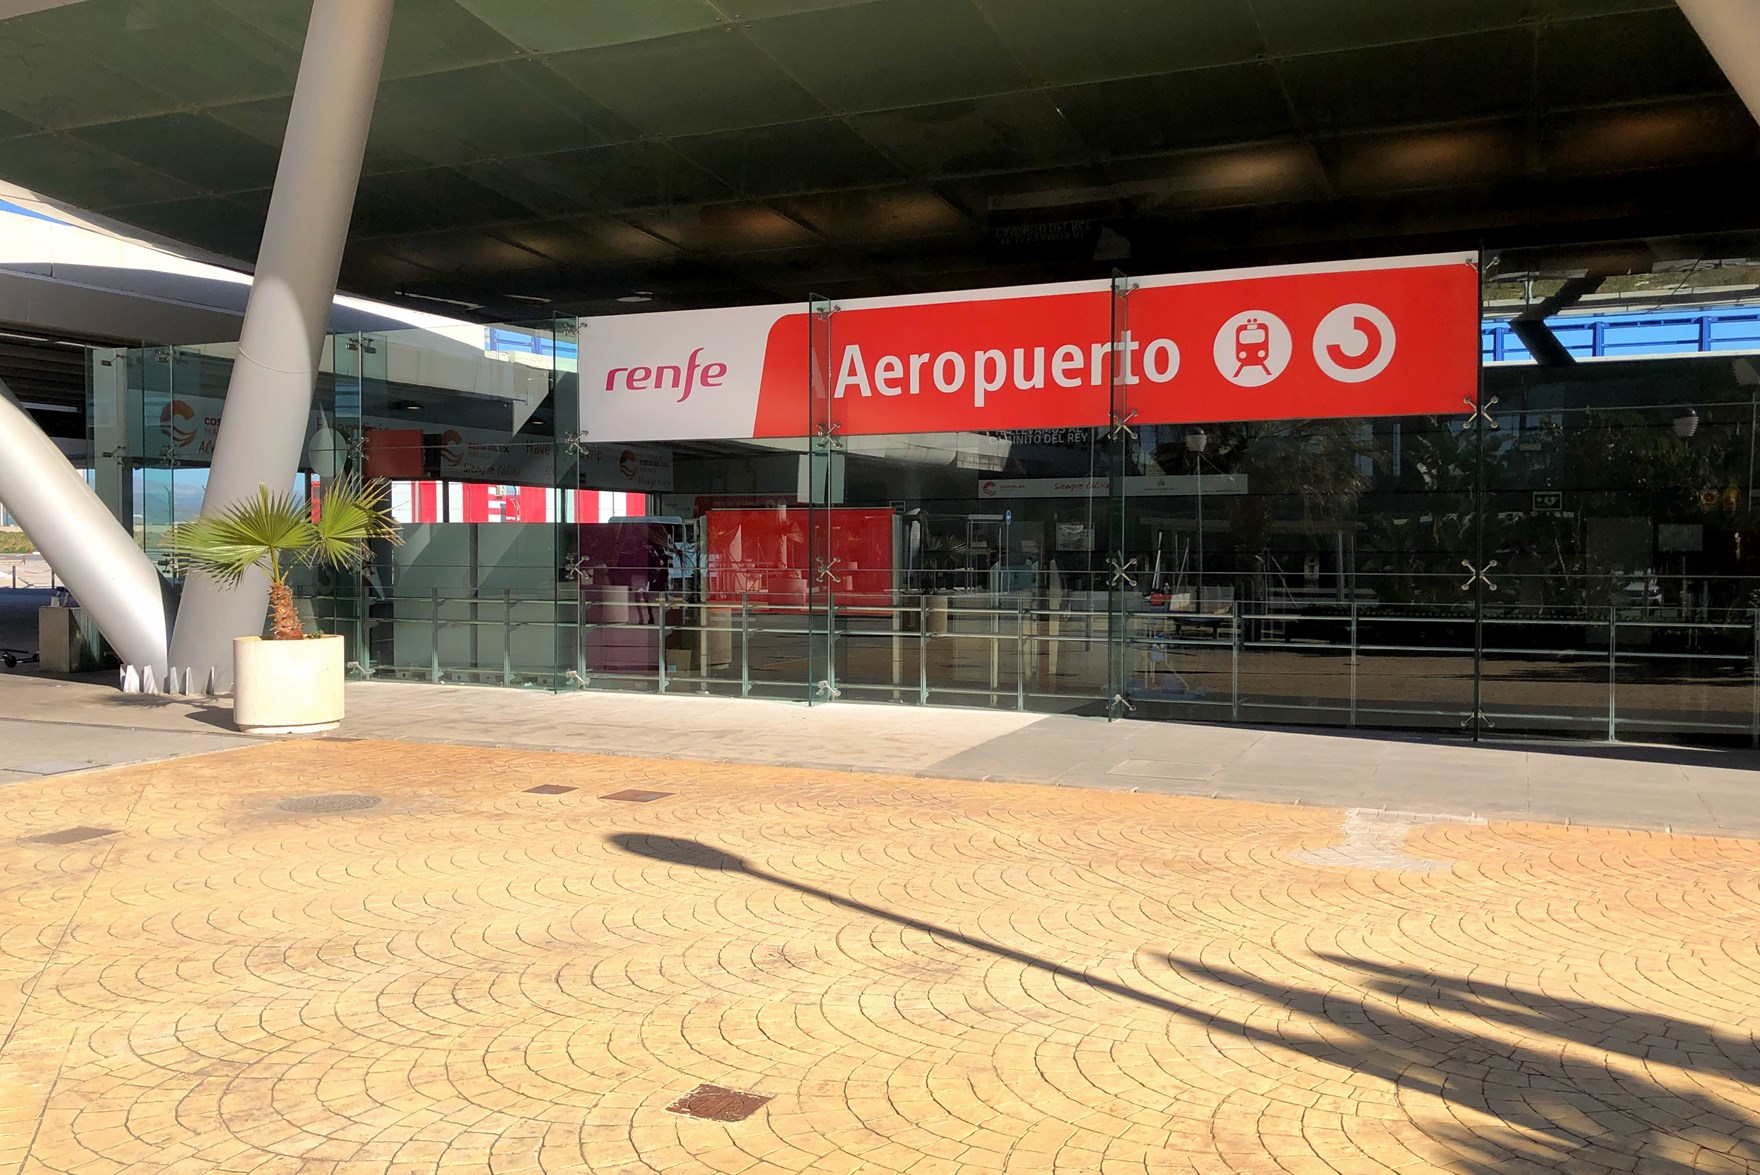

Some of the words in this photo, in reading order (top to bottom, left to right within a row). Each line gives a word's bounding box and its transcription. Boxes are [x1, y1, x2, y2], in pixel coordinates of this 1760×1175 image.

[605, 347, 728, 404] renfe
[834, 330, 1181, 408] Aeropuerto
[204, 417, 221, 426] COS
[1044, 433, 1064, 443] DEL
[1067, 433, 1088, 443] REY
[526, 438, 551, 455] Have
